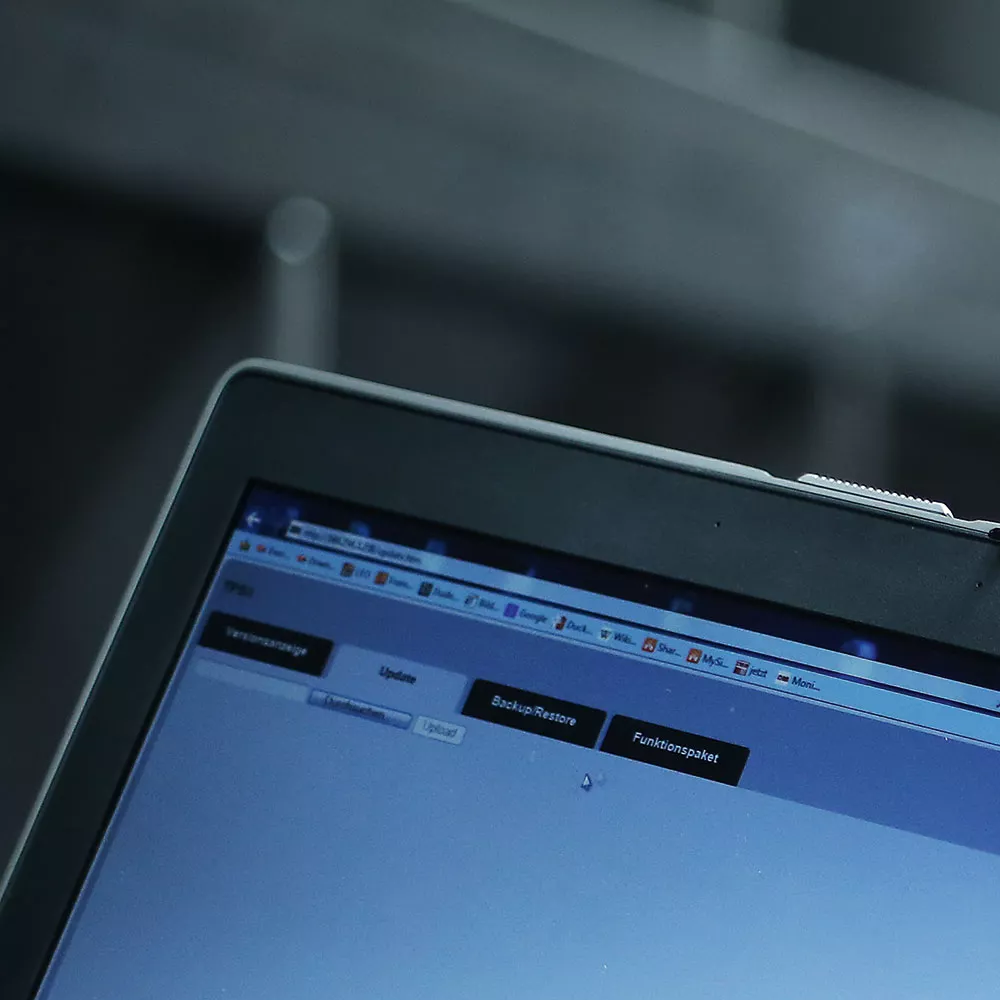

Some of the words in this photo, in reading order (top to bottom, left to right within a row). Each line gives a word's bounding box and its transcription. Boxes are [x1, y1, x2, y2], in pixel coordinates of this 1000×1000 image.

[379, 665, 417, 685] Update
[491, 694, 577, 727] Backup/Restore
[422, 718, 458, 739] Upload
[632, 730, 720, 764] Funktionspaket
